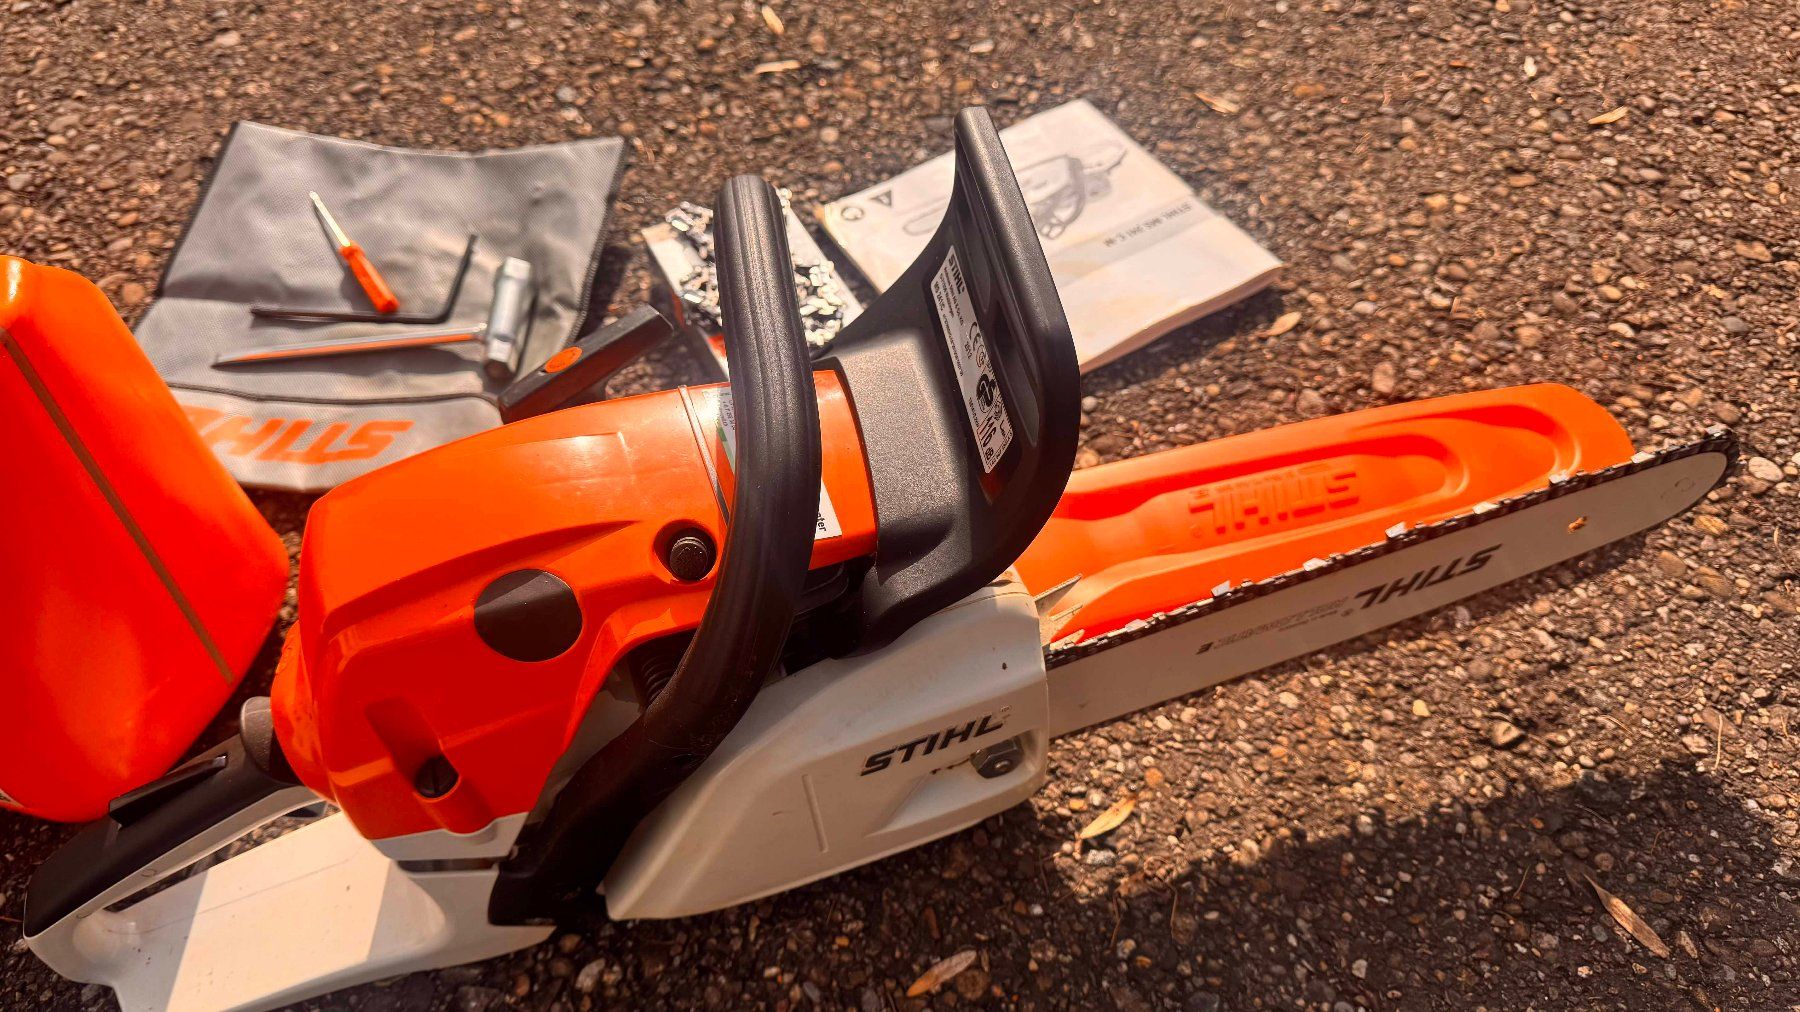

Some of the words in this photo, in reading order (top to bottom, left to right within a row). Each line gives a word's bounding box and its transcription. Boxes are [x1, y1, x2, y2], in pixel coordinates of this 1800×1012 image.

[948, 254, 965, 295] STIHL
[979, 416, 997, 448] 116
[1189, 472, 1360, 536] STIHL
[1355, 543, 1503, 610] STIHL
[861, 713, 1004, 777] STIHL
